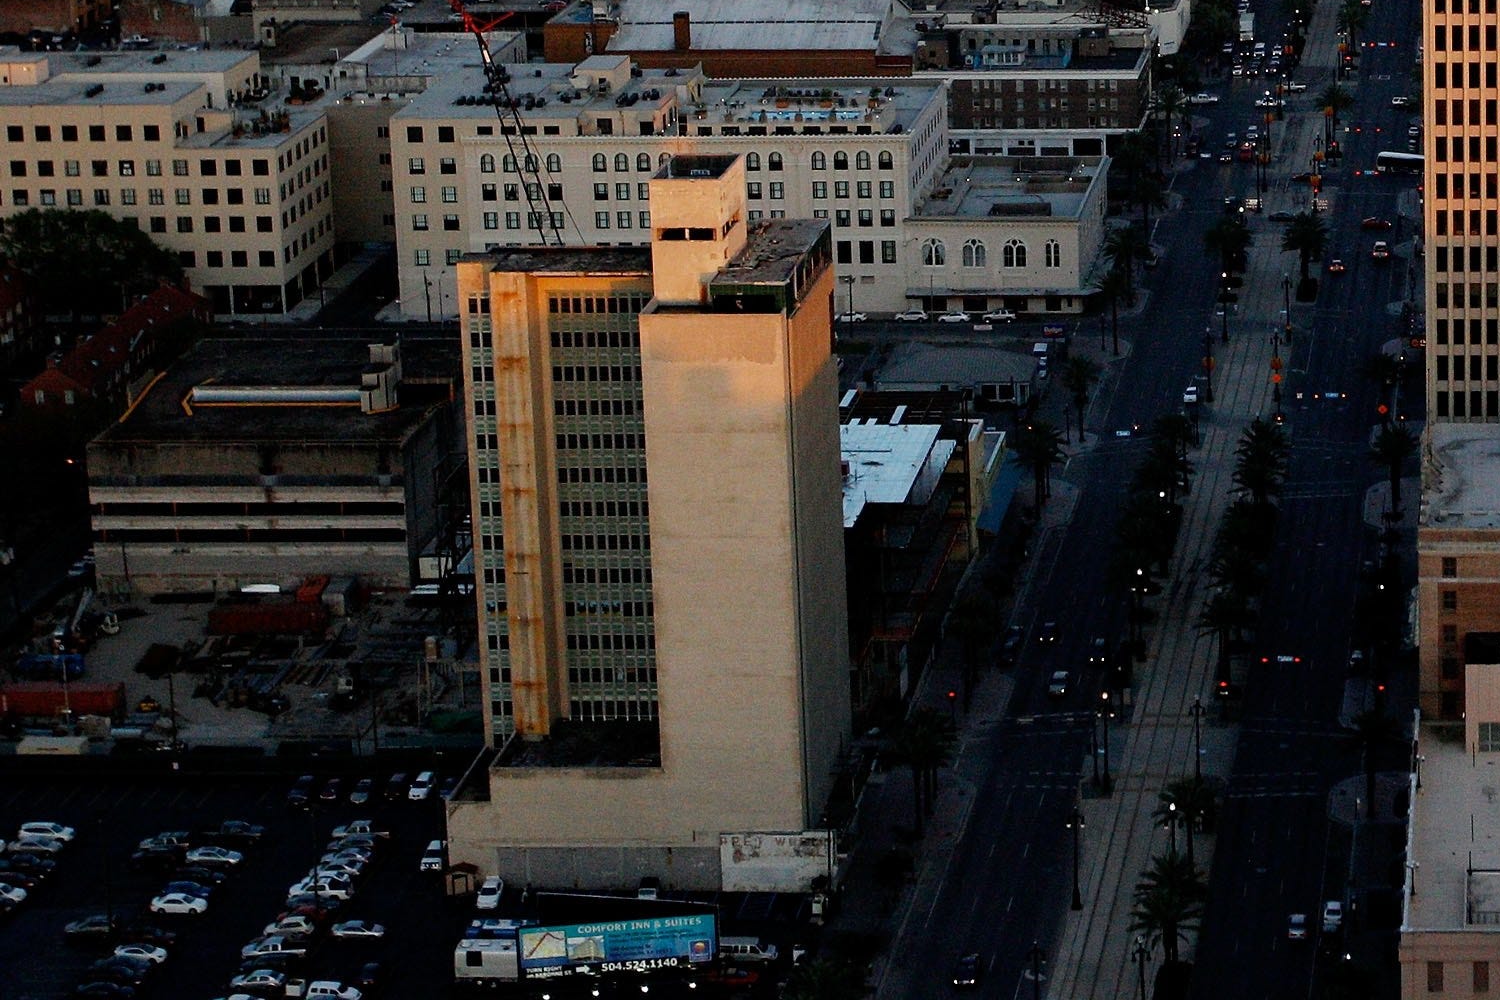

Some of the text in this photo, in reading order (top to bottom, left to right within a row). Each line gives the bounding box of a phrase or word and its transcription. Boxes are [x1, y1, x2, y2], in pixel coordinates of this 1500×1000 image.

[577, 922, 627, 934] COMFORT
[631, 920, 650, 930] INN
[665, 917, 702, 928] SUITES
[601, 957, 678, 972] 504.524.1140
